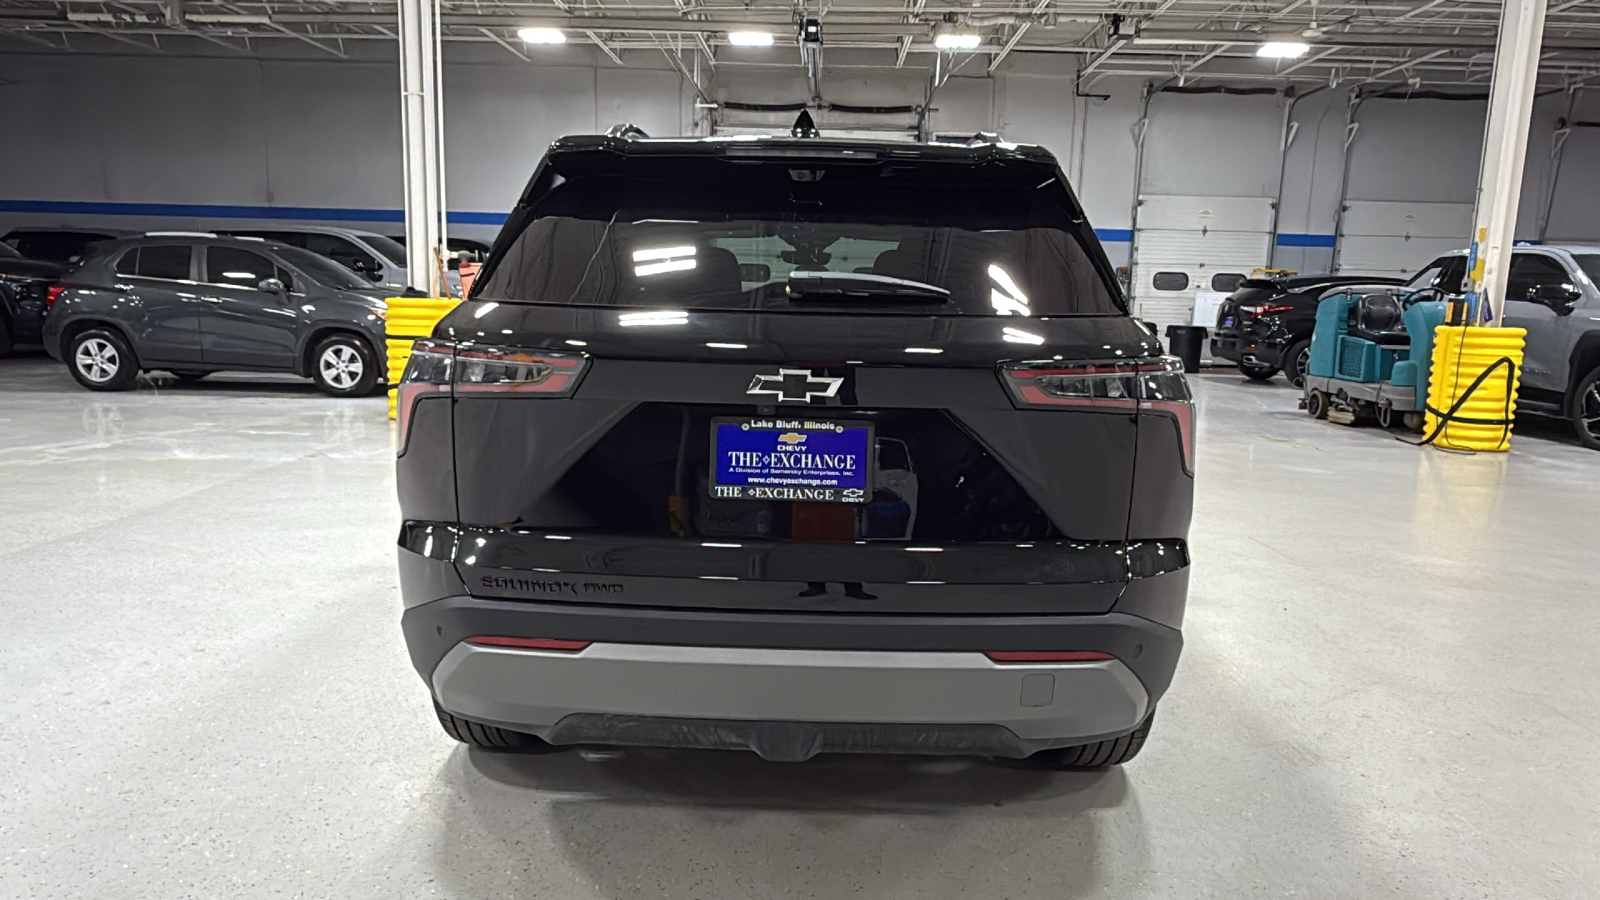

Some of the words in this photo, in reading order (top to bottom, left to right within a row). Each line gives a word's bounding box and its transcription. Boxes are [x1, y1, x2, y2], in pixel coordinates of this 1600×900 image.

[751, 420, 773, 428] Lake
[776, 420, 801, 429] Bluff,
[804, 422, 835, 430] Illinois
[728, 452, 762, 467] THE
[770, 453, 856, 470] EXCHANGE
[803, 469, 841, 477] Enterprises,
[748, 476, 838, 486] www.chevyexchange.com
[715, 486, 742, 498] THE
[756, 488, 834, 500] EXCHANGE
